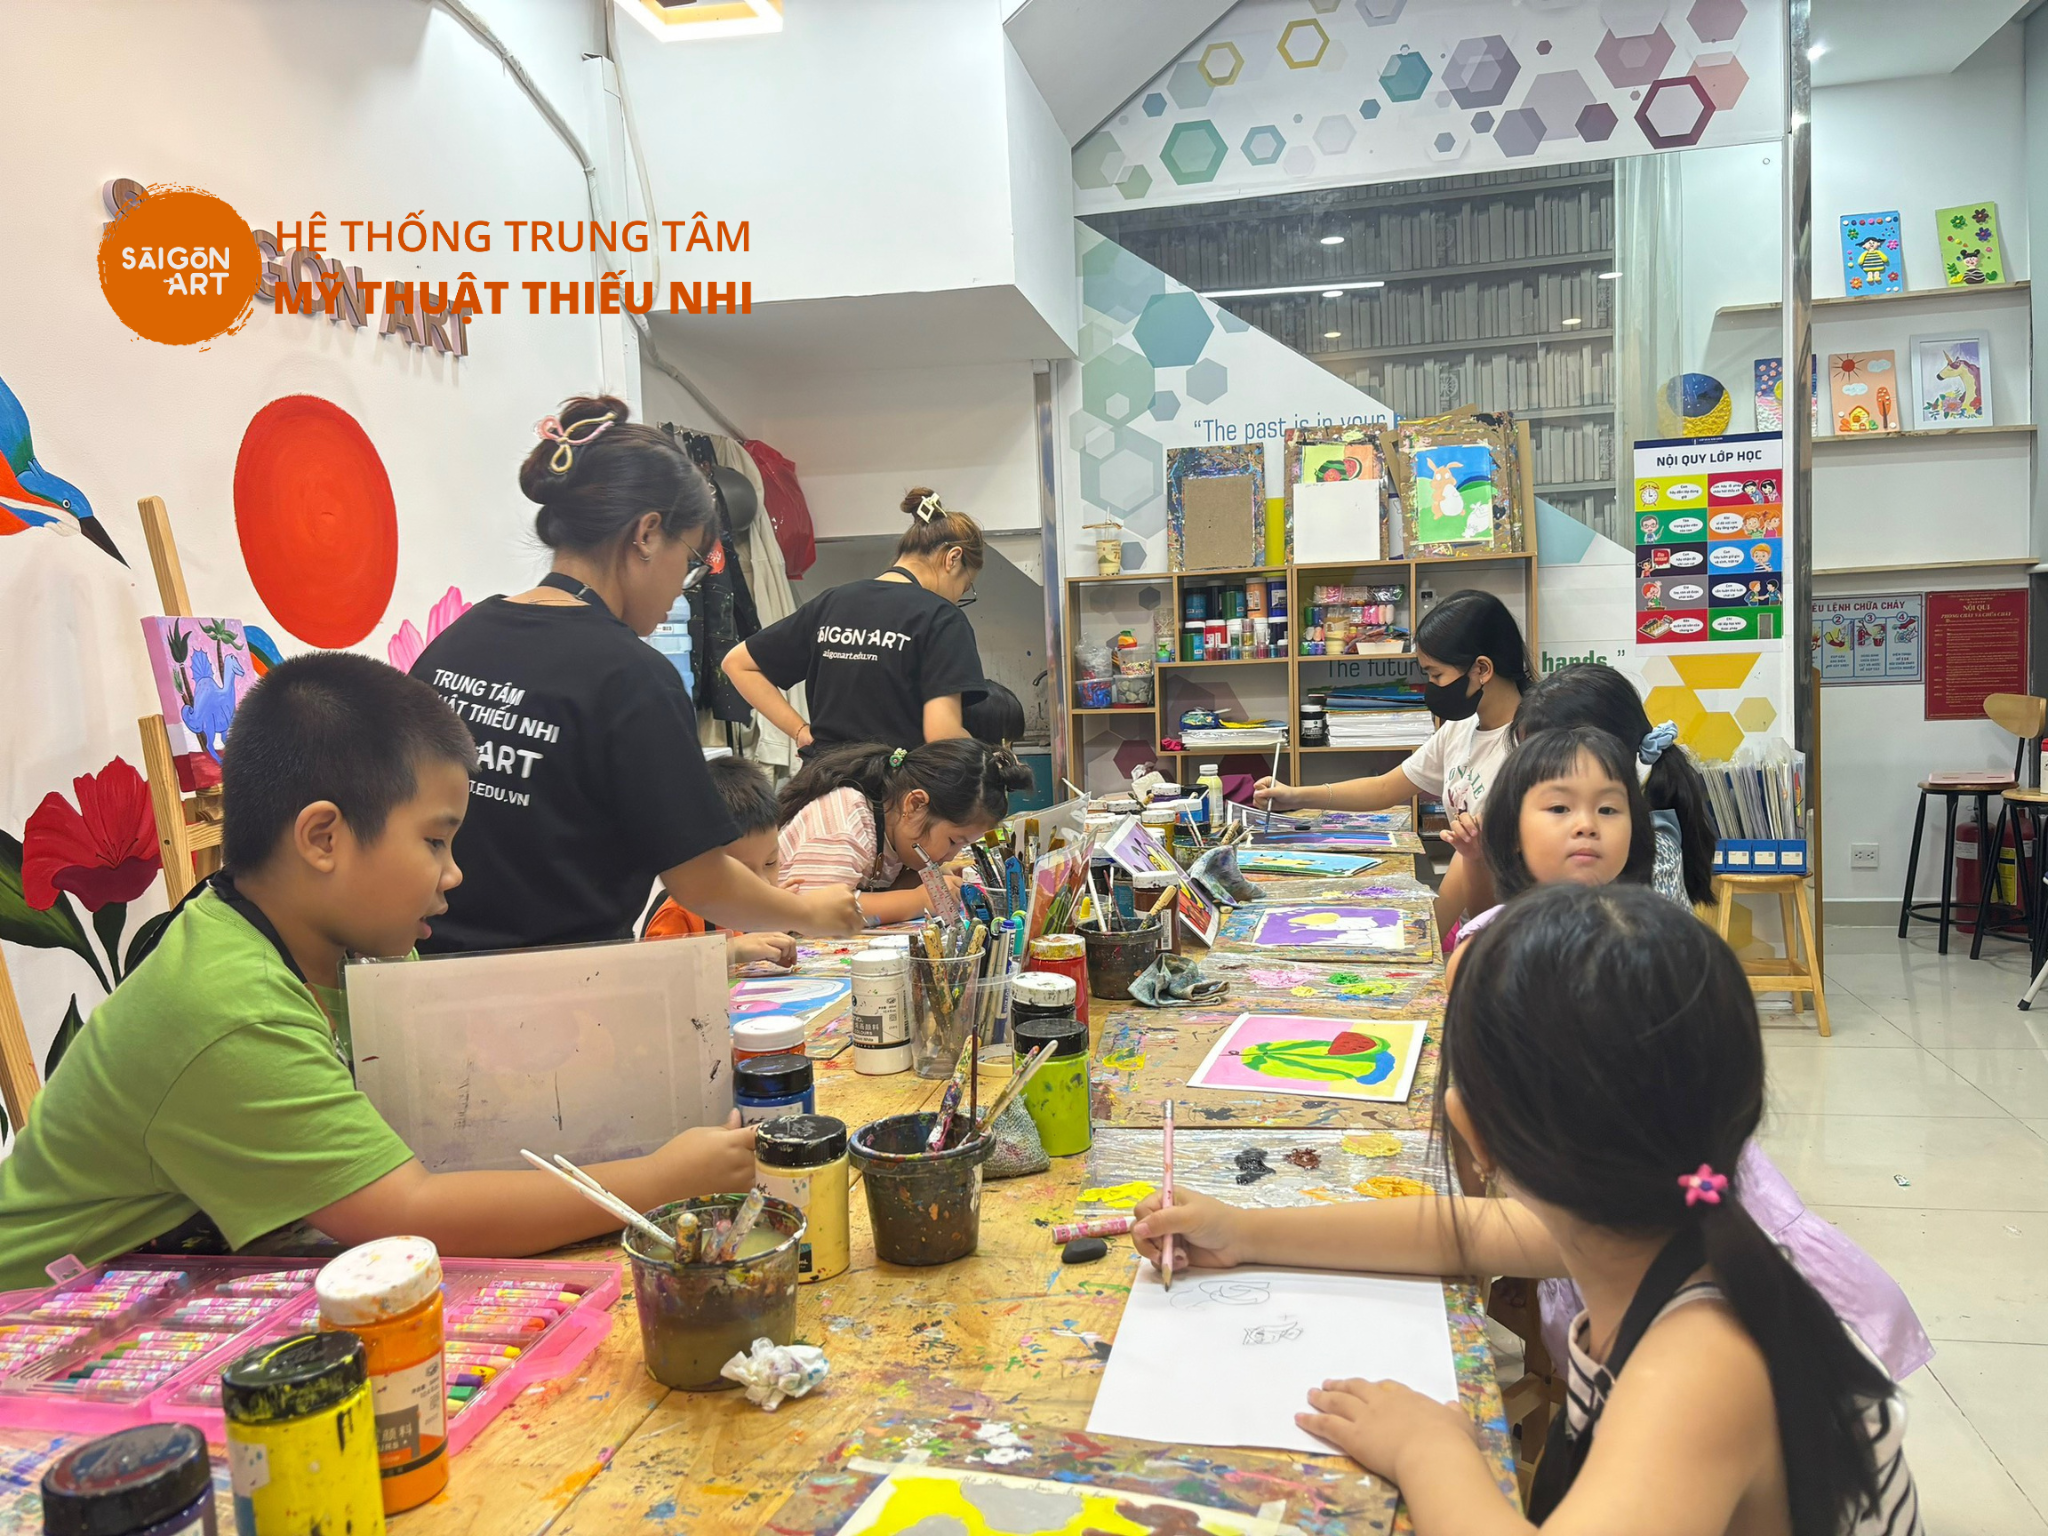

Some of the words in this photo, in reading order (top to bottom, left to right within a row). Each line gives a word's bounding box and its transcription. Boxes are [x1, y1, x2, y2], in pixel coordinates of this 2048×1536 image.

[1244, 416, 1287, 443] past
[1656, 453, 1678, 468] NỘI
[1681, 453, 1706, 466] QUY
[1710, 449, 1734, 463] LỚP
[1737, 449, 1762, 463] HỌC
[1827, 602, 1851, 613] LỆNH
[1853, 601, 1878, 611] CHỮA
[1881, 599, 1906, 610] CHÁY
[867, 628, 912, 652] ART
[432, 668, 488, 697] TRUNG
[488, 681, 526, 706] TÂM
[468, 702, 519, 731] THIẾU
[518, 717, 561, 743] NHI
